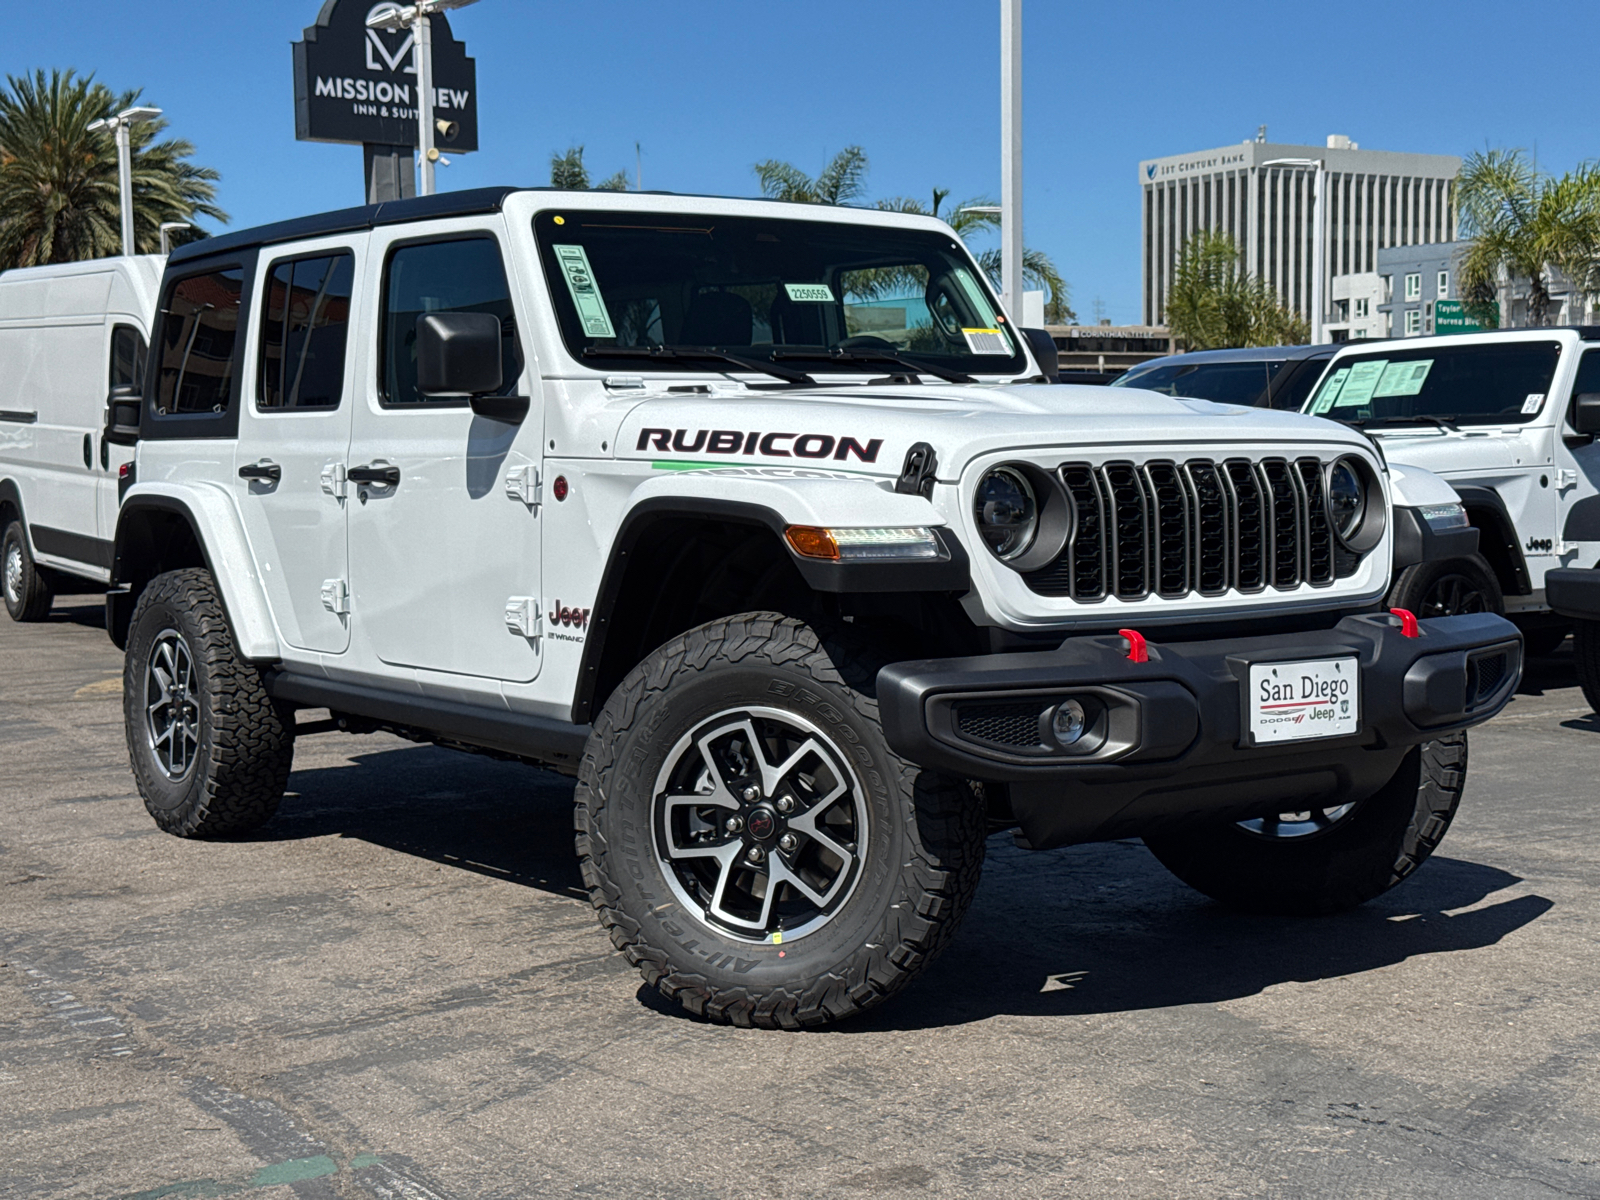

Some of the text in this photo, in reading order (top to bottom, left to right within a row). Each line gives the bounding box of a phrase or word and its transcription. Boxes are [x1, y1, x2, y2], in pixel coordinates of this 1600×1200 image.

[315, 75, 469, 110] MISSION IEW
[353, 103, 419, 120] INN & SUIT
[1221, 153, 1244, 165] BANK
[791, 288, 828, 299] 2250559
[1437, 304, 1460, 314] Taylor
[636, 428, 884, 463] RUBICON
[1525, 536, 1553, 553] Jeep
[555, 633, 584, 643] WRANG
[1260, 674, 1349, 704] San Diego
[1309, 707, 1335, 721] Jeep
